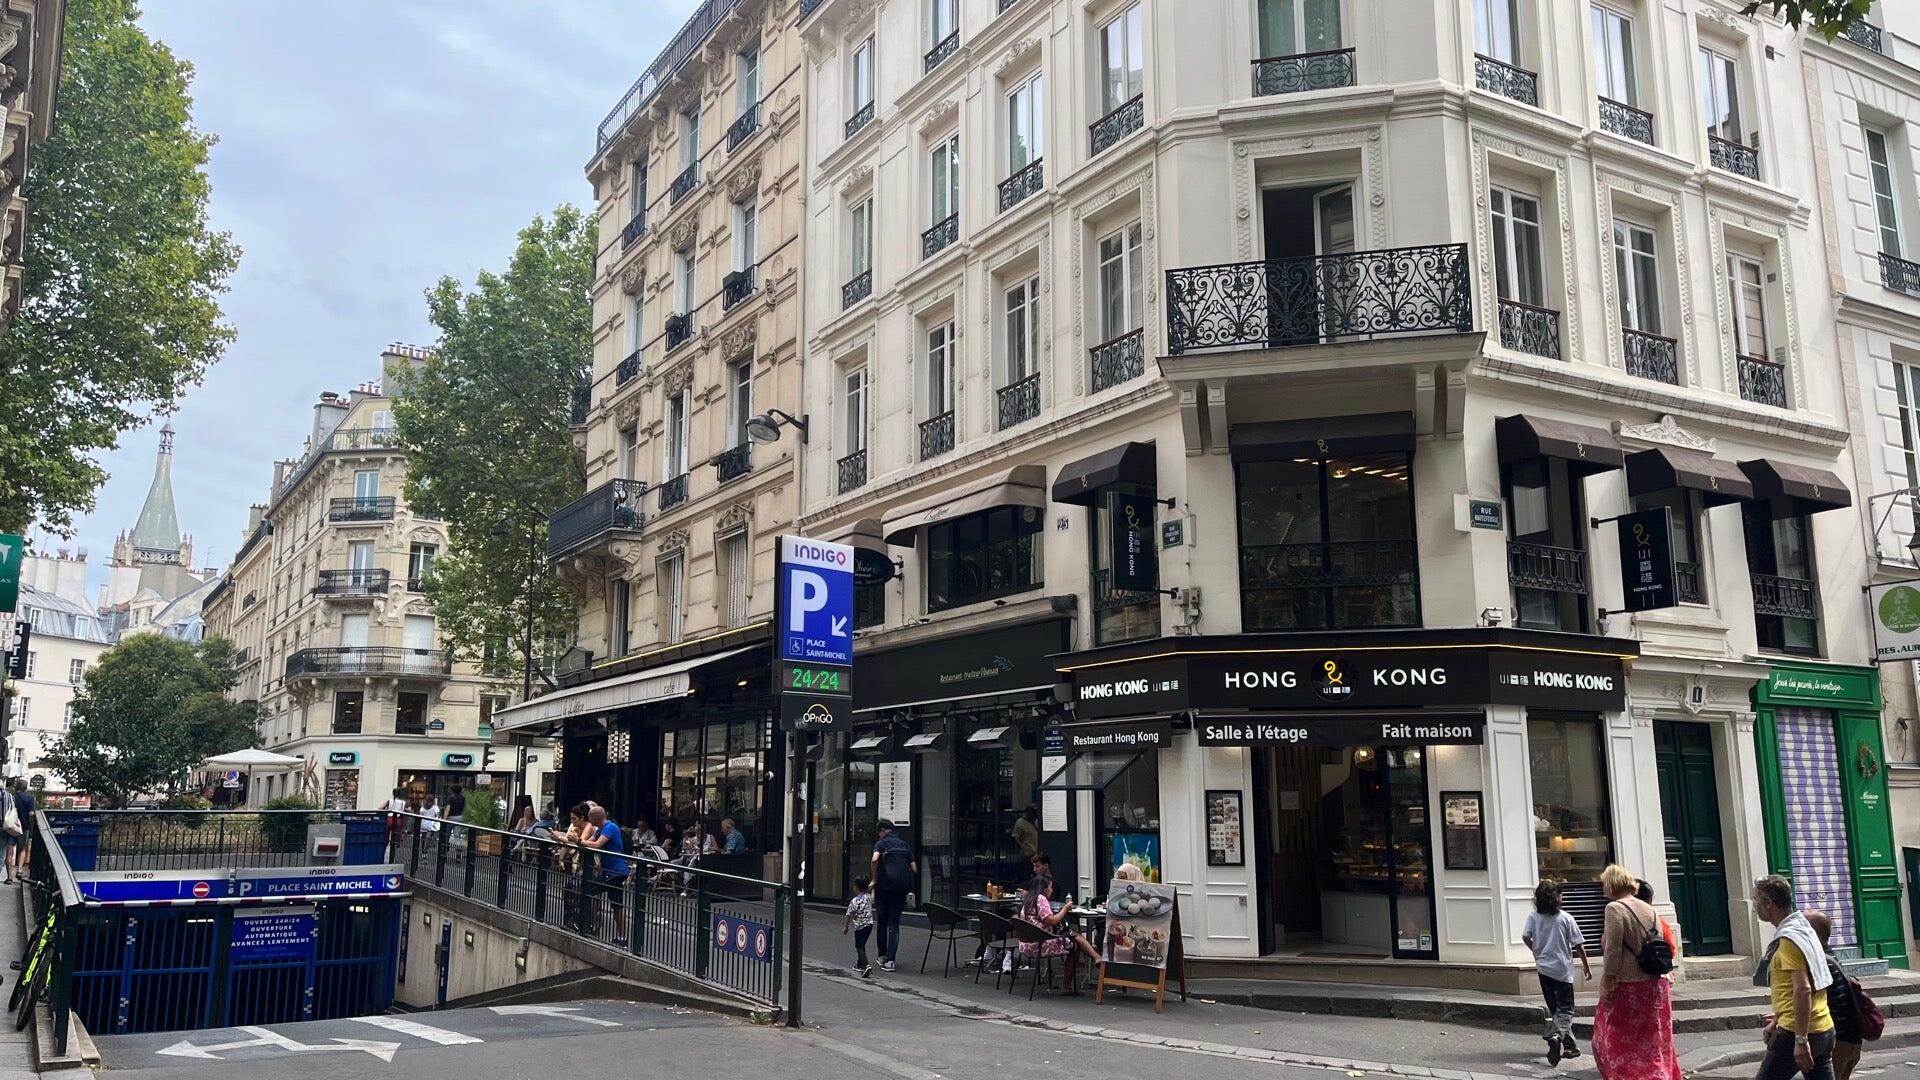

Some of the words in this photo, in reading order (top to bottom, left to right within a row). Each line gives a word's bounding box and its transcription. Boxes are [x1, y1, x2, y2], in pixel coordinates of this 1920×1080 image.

[1480, 507, 1492, 515] RUE
[794, 544, 846, 566] INDIGO
[789, 569, 829, 633] P
[806, 638, 826, 648] PLACE
[806, 649, 847, 660] SAINT-MICHEL
[791, 668, 840, 690] 24/24
[1224, 671, 1297, 689] HONG
[1373, 667, 1447, 686] KONG
[1533, 671, 1574, 689] HONG
[1575, 673, 1613, 691] KONG
[1080, 683, 1113, 700] HONG
[1115, 679, 1149, 696] KONG
[1073, 734, 1113, 746] Restaurant
[1114, 732, 1136, 745] Hong
[1137, 731, 1159, 743] Kong
[1206, 725, 1242, 740] Salle
[1245, 725, 1254, 740] à
[1382, 723, 1412, 738] Fait
[1414, 723, 1472, 739] maison
[331, 754, 352, 762] Normal
[449, 756, 470, 764] Normal
[239, 881, 252, 897] P
[268, 883, 300, 893] PLACE
[303, 882, 333, 892] SAINT
[335, 880, 373, 891] MICHEL
[244, 931, 297, 939] AUTOMATIQUE
[267, 937, 309, 945] LENTEMENT
